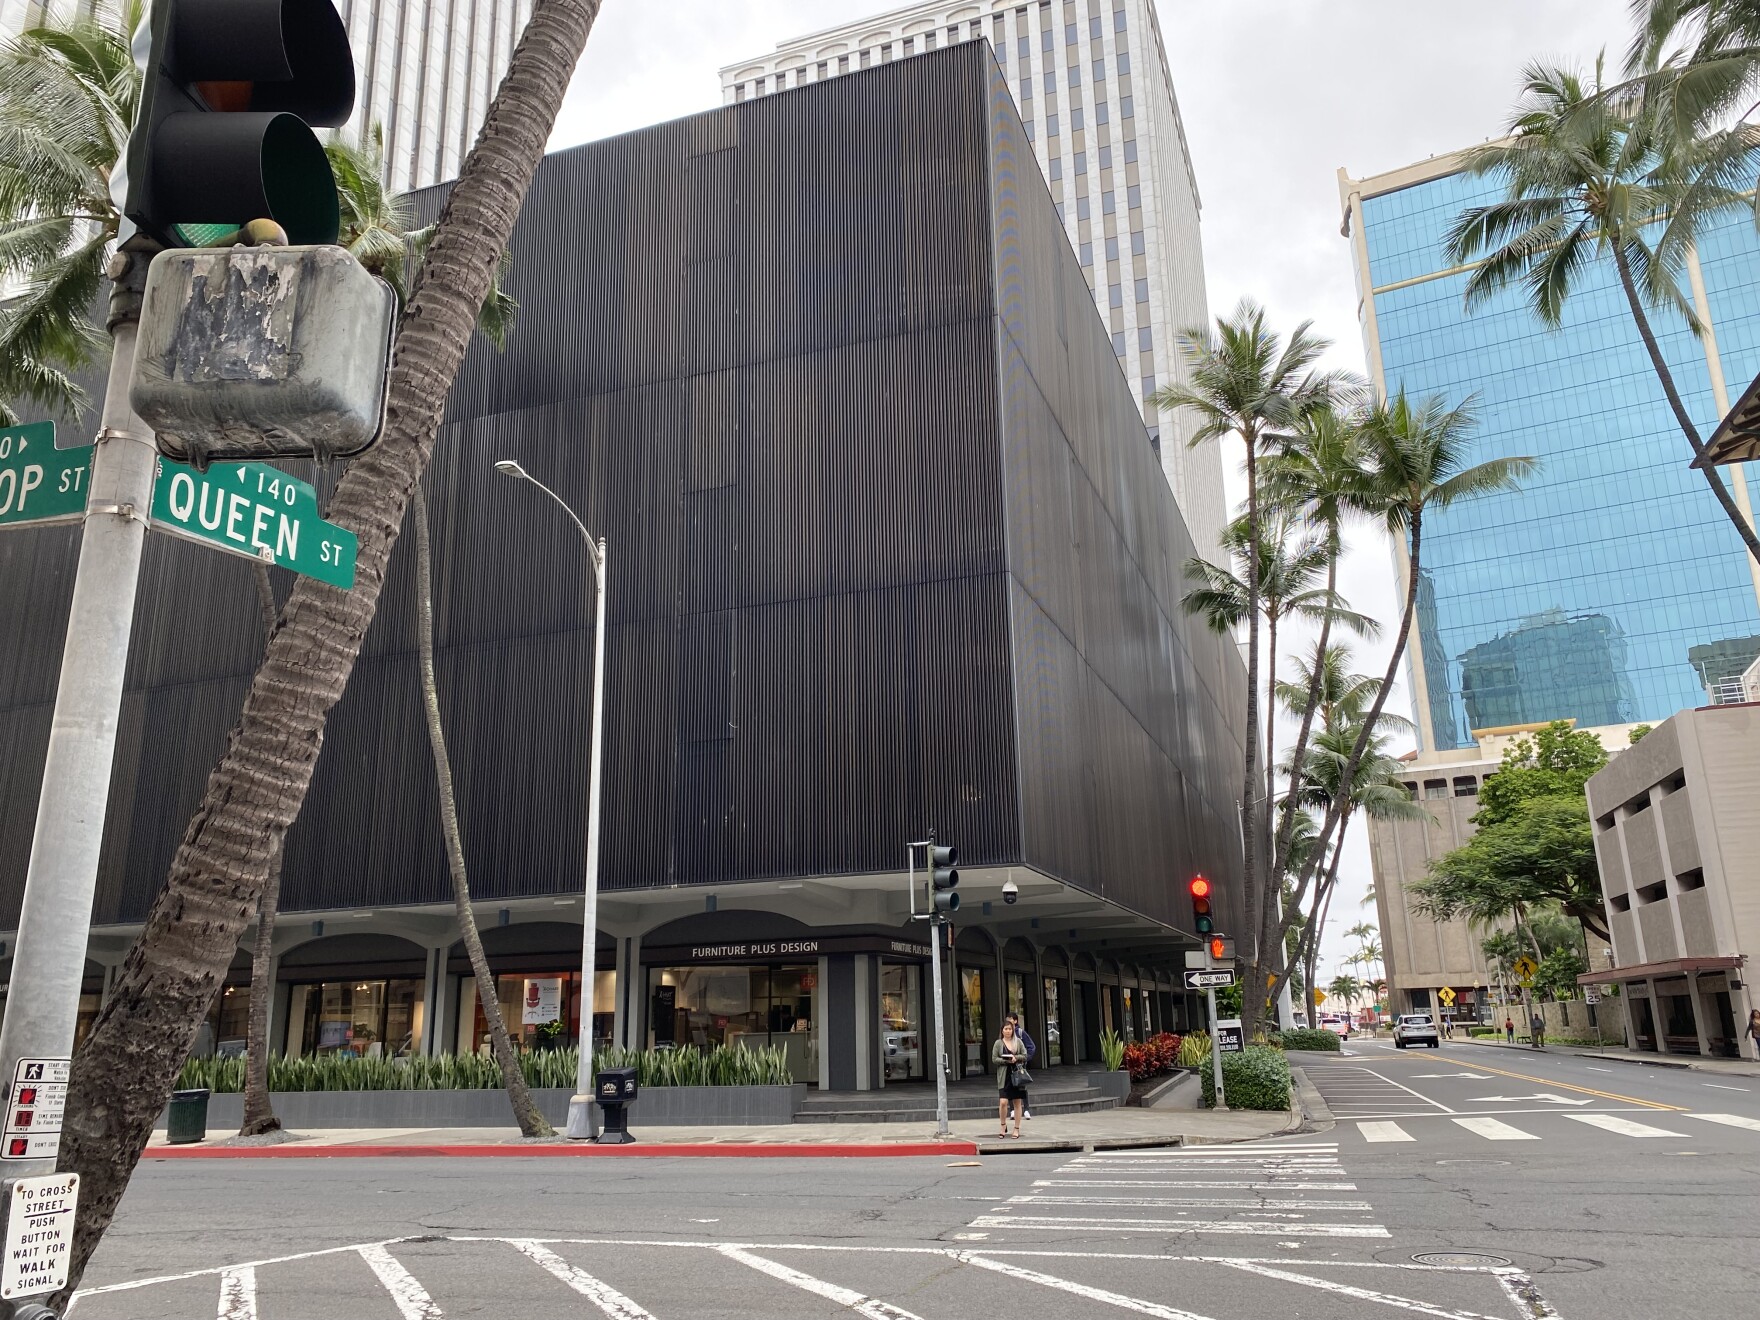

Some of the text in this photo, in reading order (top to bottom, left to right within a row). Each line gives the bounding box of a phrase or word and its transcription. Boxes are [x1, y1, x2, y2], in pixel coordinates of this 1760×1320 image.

[58, 466, 85, 493] ST
[257, 472, 296, 506] 140
[169, 472, 343, 566] QUEEN ST
[692, 941, 818, 957] FURNITURE PLUS DESIGN
[1218, 1036, 1238, 1044] LEASE
[22, 1185, 72, 1200] TO CROSS
[25, 1199, 65, 1213] STREET
[30, 1216, 56, 1228] PUSH
[21, 1230, 61, 1244] BUTTON
[13, 1242, 66, 1260] WAIT FOR
[20, 1258, 56, 1274] WALK
[17, 1274, 53, 1289] SIGNAL
